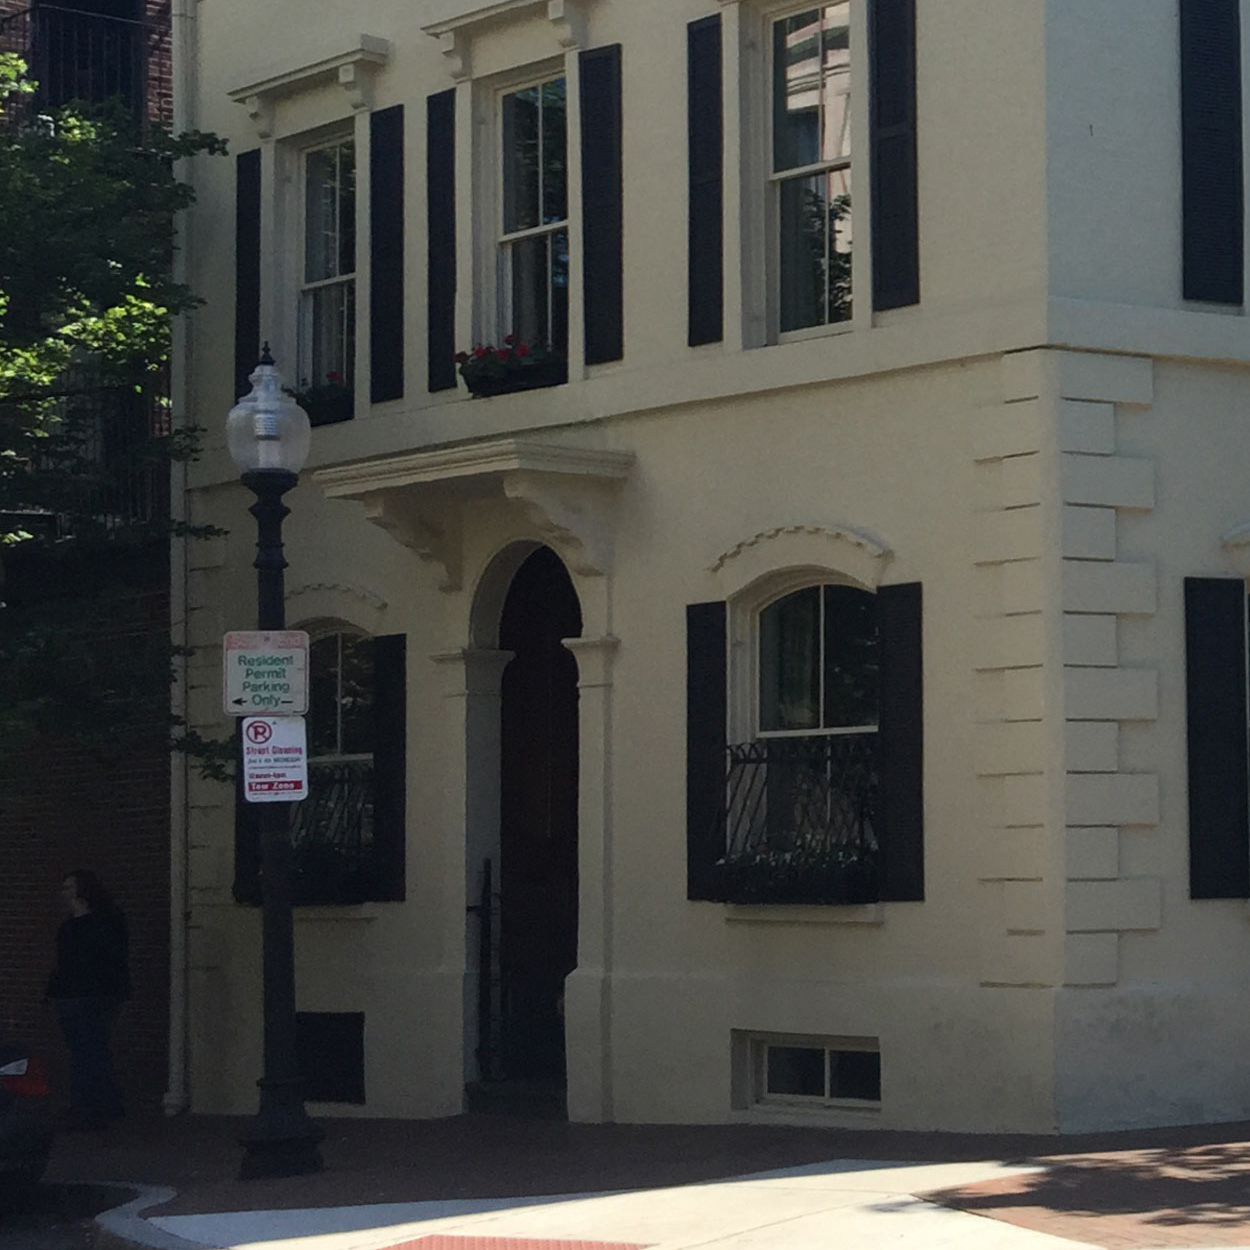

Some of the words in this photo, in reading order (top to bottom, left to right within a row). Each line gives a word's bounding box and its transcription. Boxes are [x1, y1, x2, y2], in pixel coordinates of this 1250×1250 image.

[238, 654, 295, 666] Resident
[245, 667, 287, 679] Permit
[242, 680, 290, 694] Parking
[251, 694, 281, 708] Only
[251, 782, 269, 790] Tow
